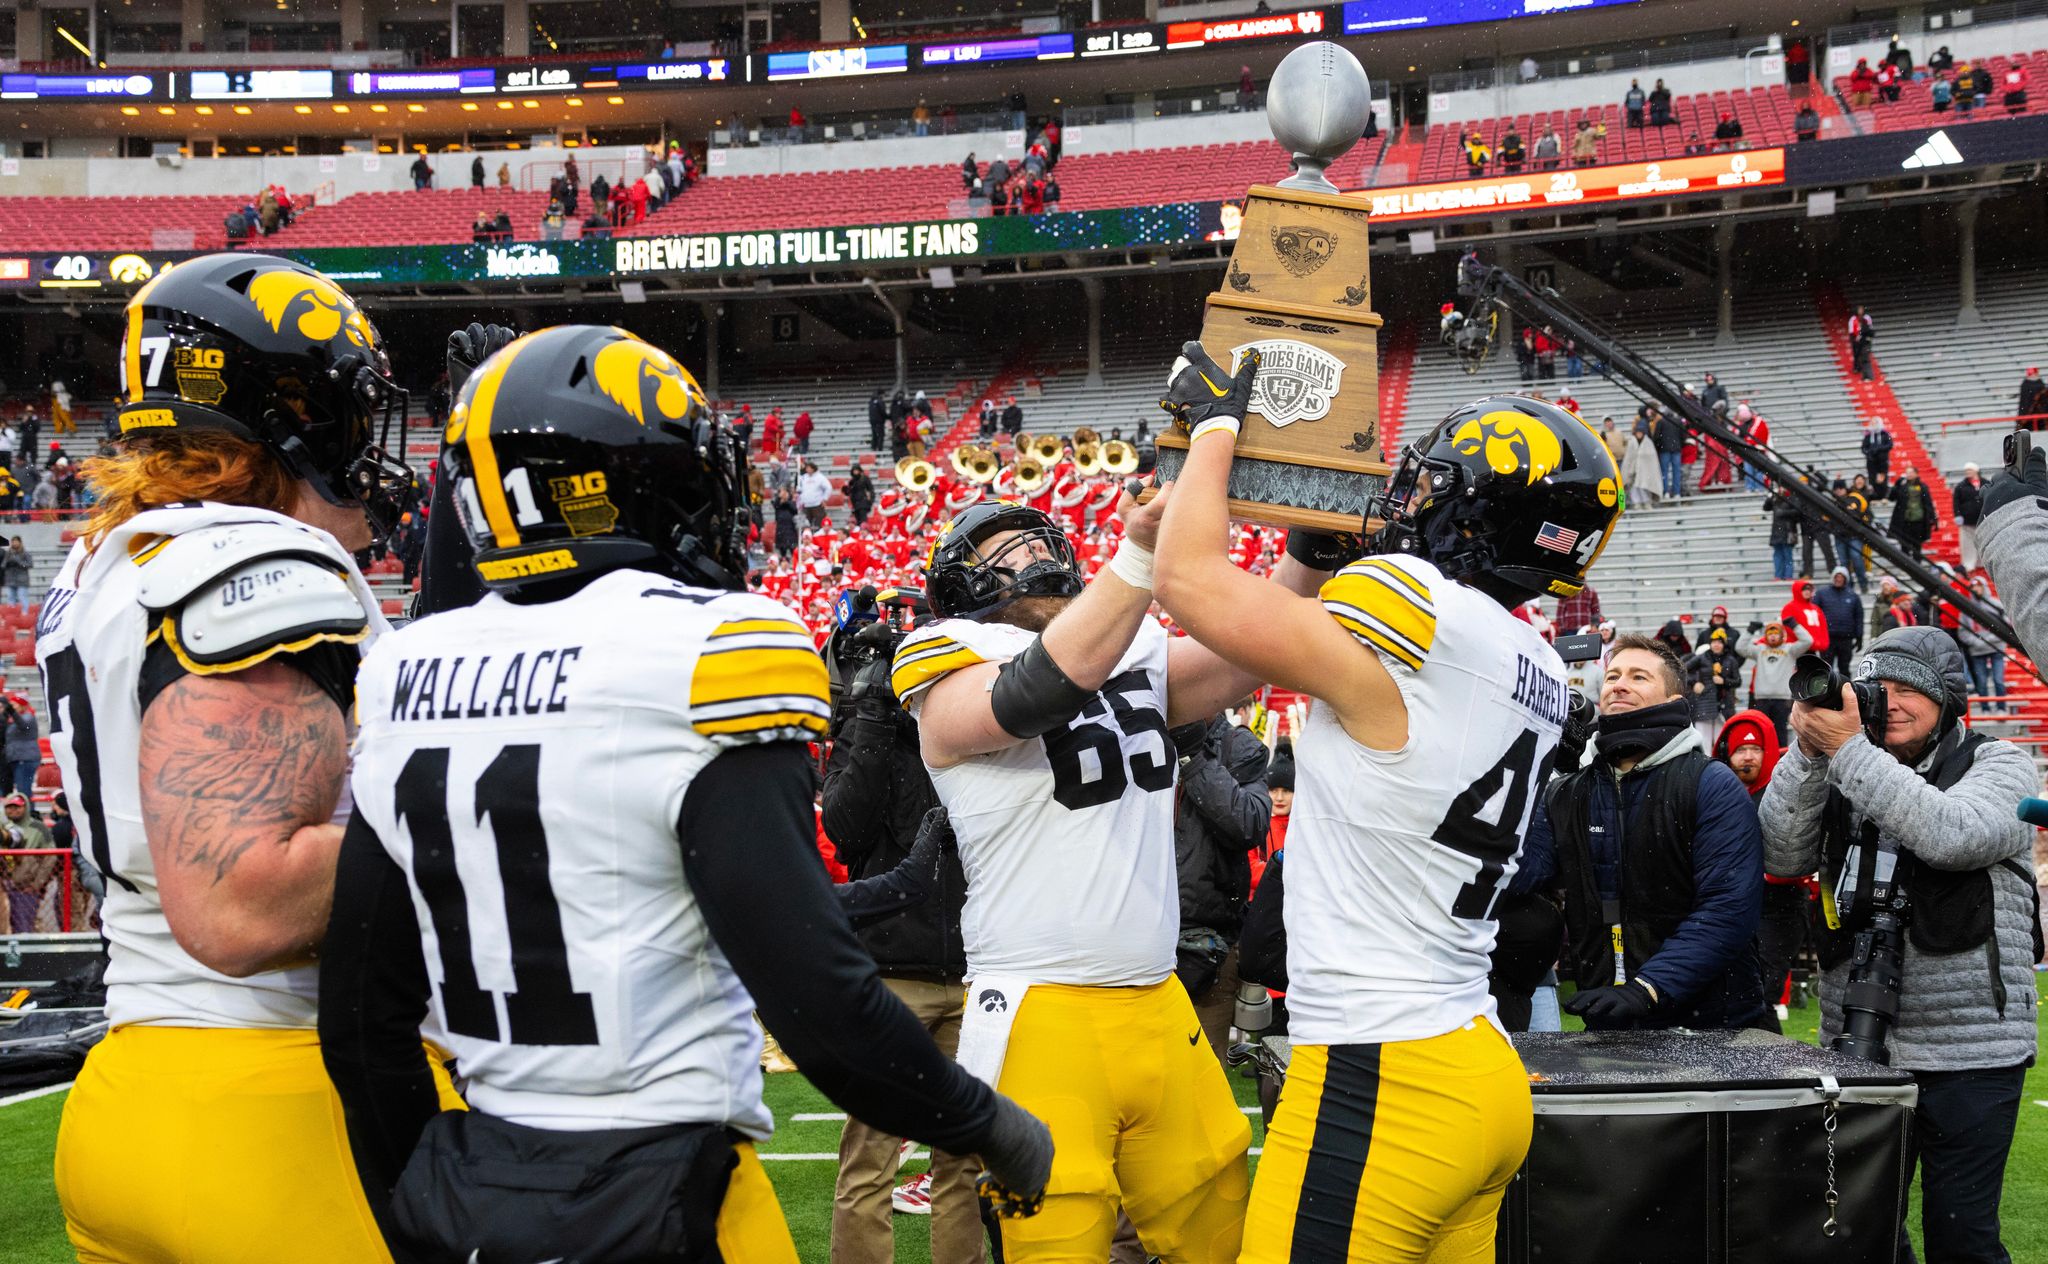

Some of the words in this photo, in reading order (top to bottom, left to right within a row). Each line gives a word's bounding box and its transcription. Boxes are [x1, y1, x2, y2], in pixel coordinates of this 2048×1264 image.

[1214, 18, 1293, 40] OKLAHOMA
[954, 46, 982, 61] LSU
[1087, 36, 1111, 51] SAT
[507, 71, 531, 86] SAT
[647, 64, 702, 81] ILLINOIS
[1646, 163, 1661, 182] 2
[1731, 154, 1747, 173] 0
[1550, 172, 1577, 192] 20
[1403, 182, 1531, 212] LINDENMEYER
[615, 236, 721, 271] BREWED
[726, 234, 775, 267] FOR
[780, 226, 909, 263] FULL-TIME
[912, 222, 979, 257] FANS
[1316, 240, 1323, 248] N
[53, 255, 90, 280] 40
[780, 317, 792, 337] 8
[1276, 344, 1304, 353] THE
[1260, 350, 1294, 368] ROES
[1296, 353, 1335, 391] GAME
[1304, 397, 1319, 410] N
[1576, 529, 1603, 566] 4
[391, 646, 582, 722] WALLACE
[1042, 669, 1176, 811] 65
[394, 743, 600, 1045] 11
